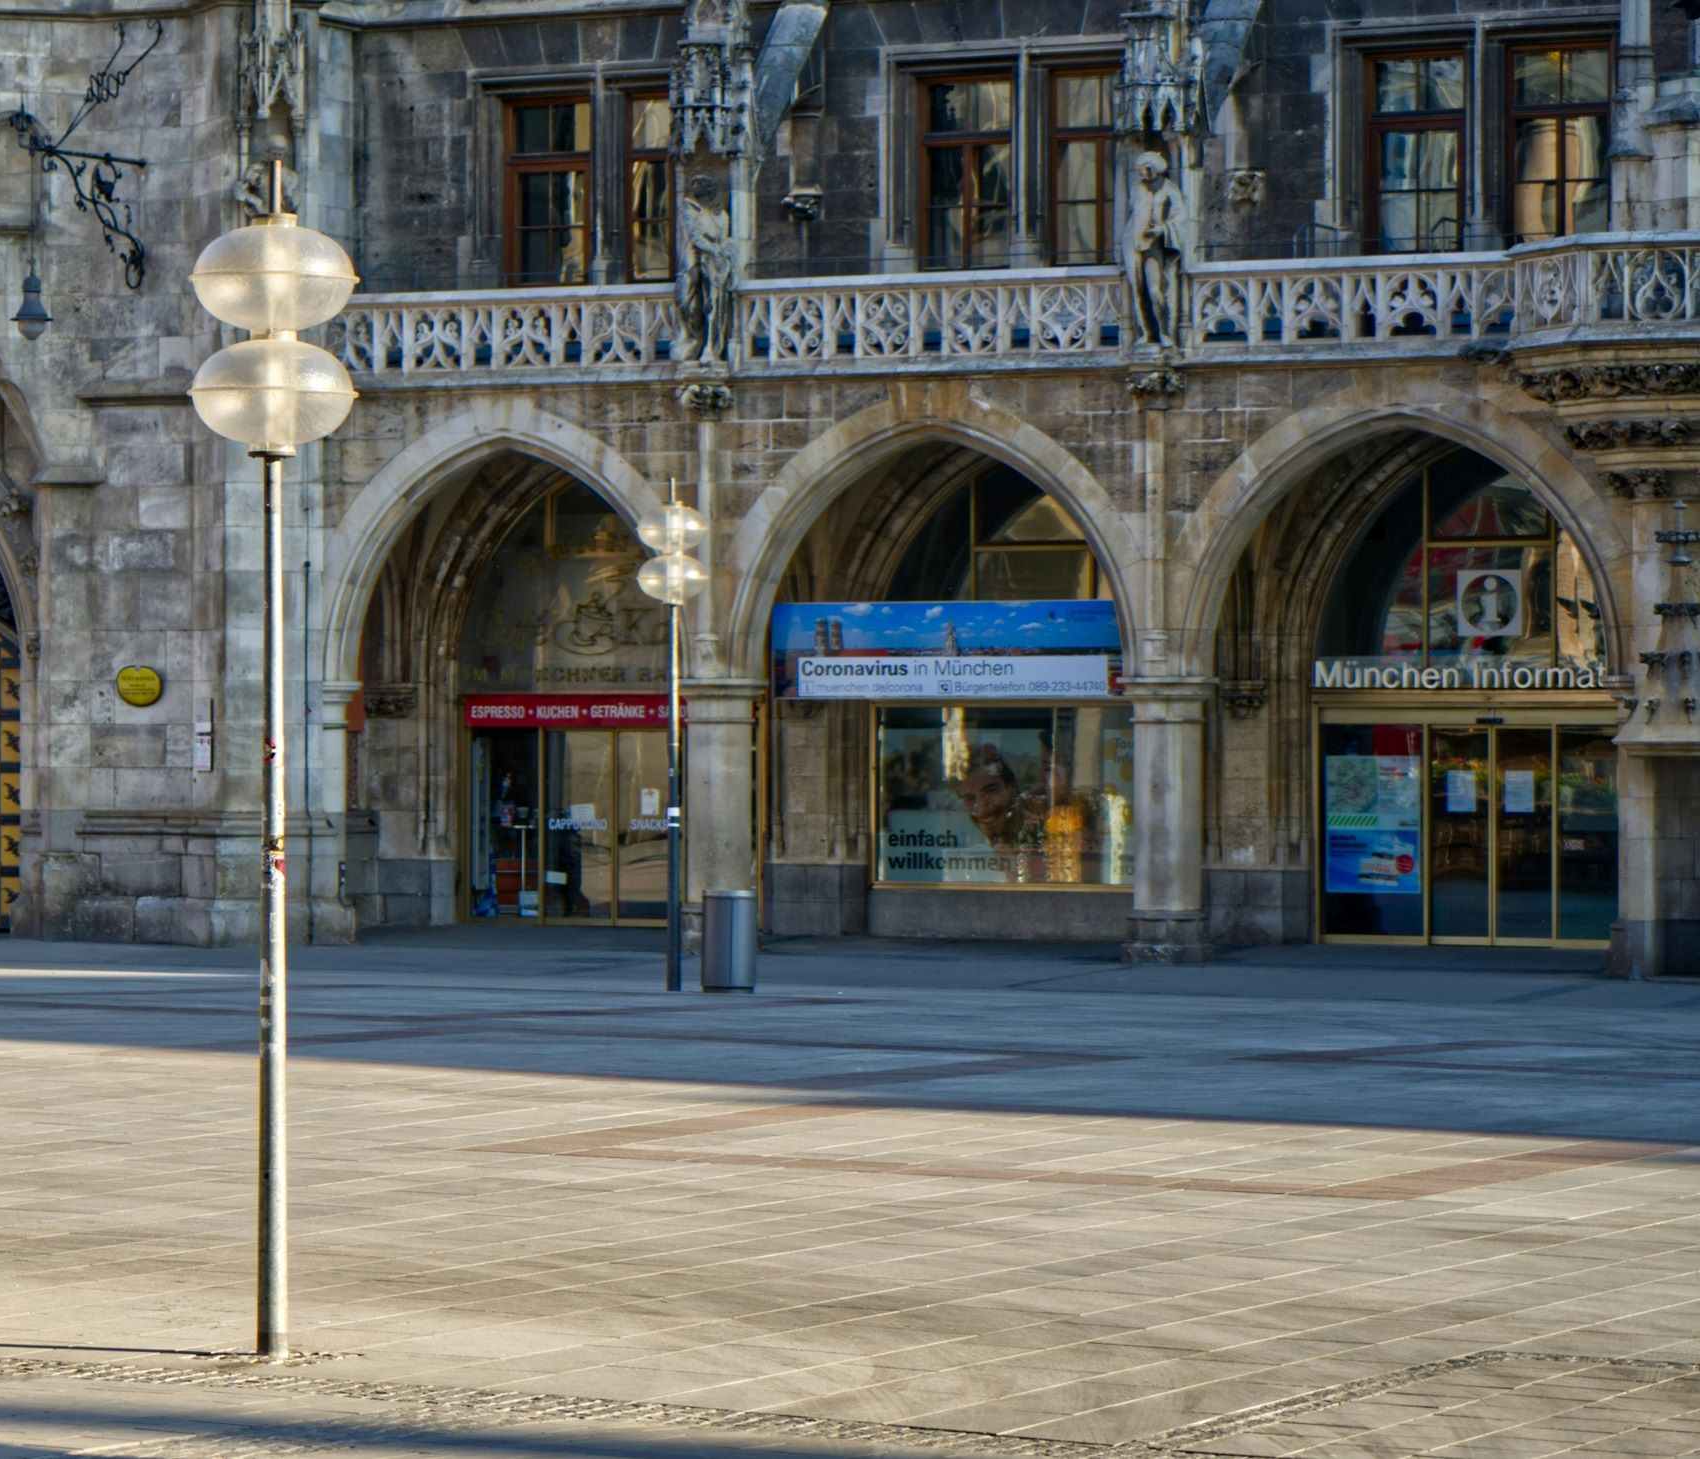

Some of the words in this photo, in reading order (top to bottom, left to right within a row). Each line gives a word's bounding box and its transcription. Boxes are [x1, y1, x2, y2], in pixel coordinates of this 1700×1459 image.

[801, 660, 909, 677] Coronavirus
[913, 660, 928, 676] in
[934, 659, 1014, 676] München
[1315, 660, 1459, 689] München
[816, 682, 924, 694] muenchen.de/corona
[954, 681, 1026, 694] Bürgertelefon
[471, 706, 525, 719] ESPRESSO
[536, 706, 579, 719] KUCHEN
[590, 703, 646, 719] GETRÄNKE
[548, 818, 608, 830] CAPPUCCINO
[630, 818, 669, 831] SNACKS
[888, 830, 959, 848] einfach
[888, 852, 1011, 871] willkommen
